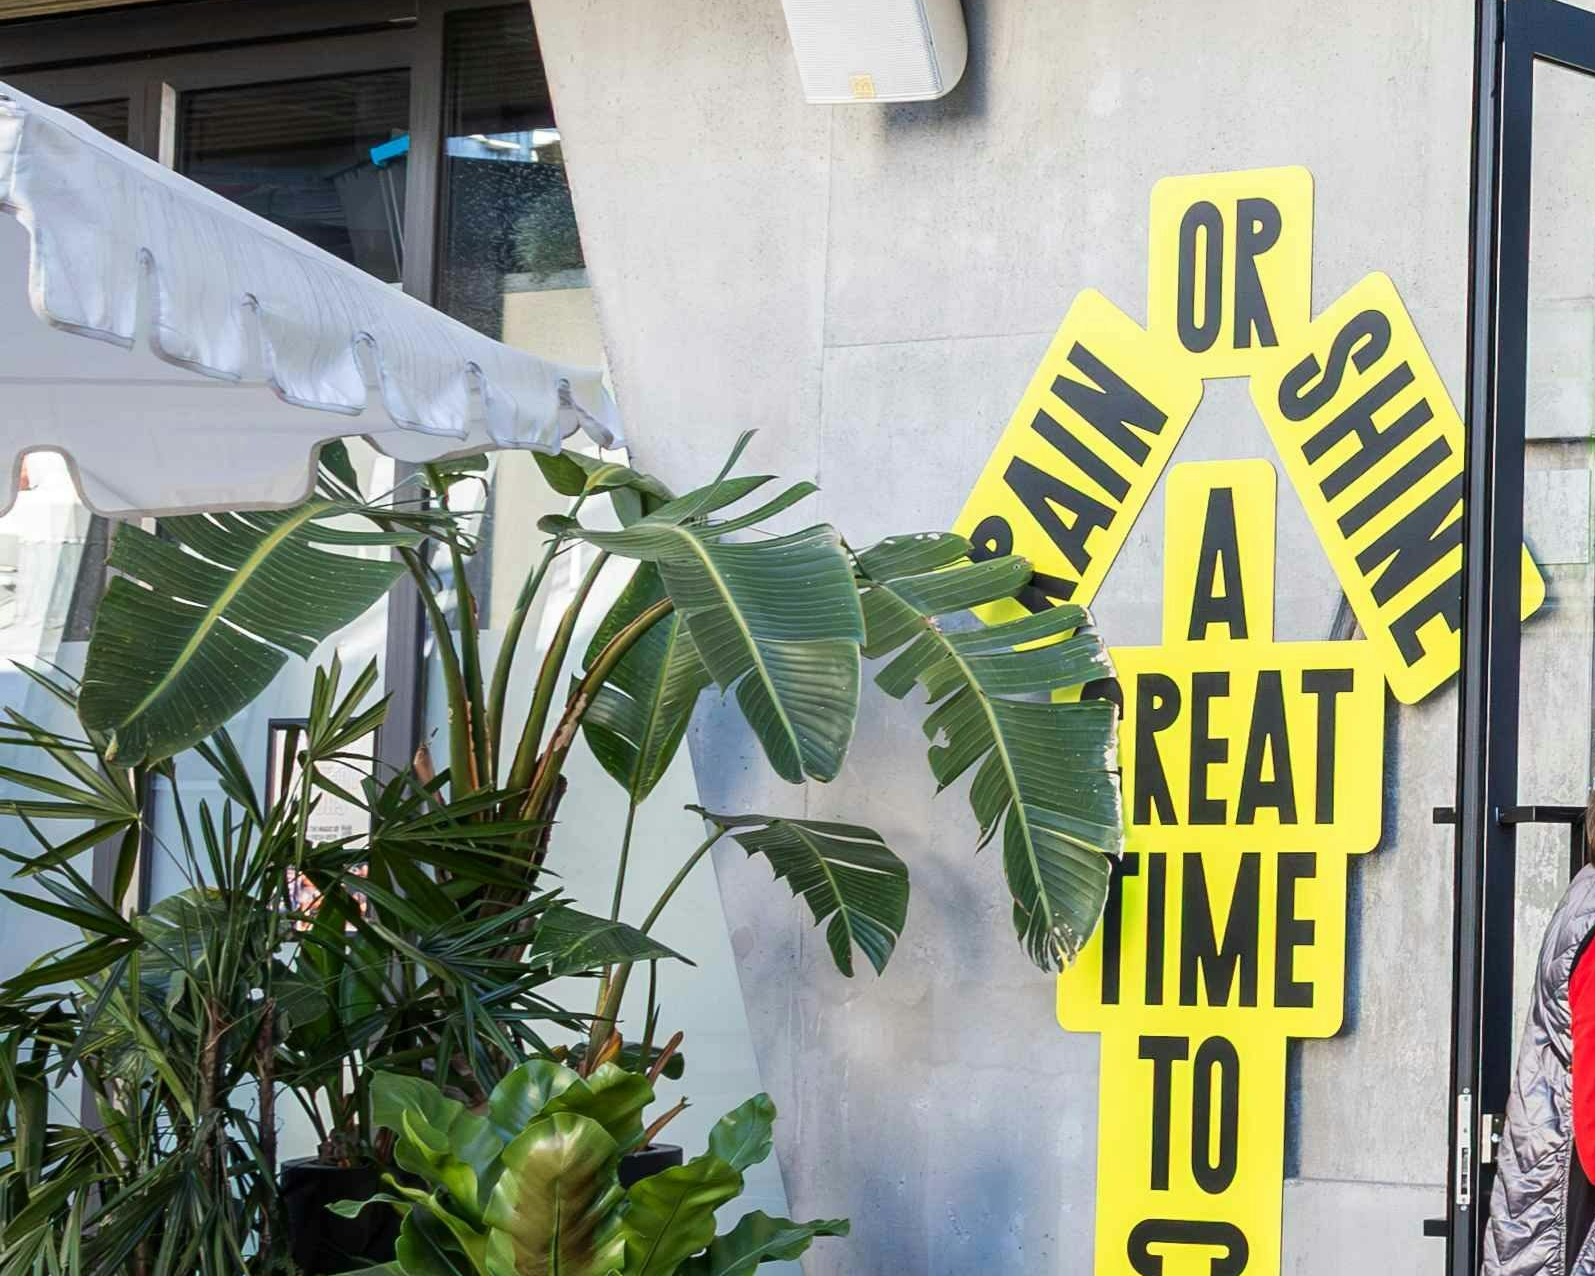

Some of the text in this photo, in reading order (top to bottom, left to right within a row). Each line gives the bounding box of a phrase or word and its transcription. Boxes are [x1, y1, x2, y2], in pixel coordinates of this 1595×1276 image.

[1176, 197, 1282, 354] OR
[1188, 487, 1249, 642] A
[1081, 668, 1354, 826] REAT
[1101, 851, 1316, 1008] TIME
[1138, 1034, 1240, 1195] TO
